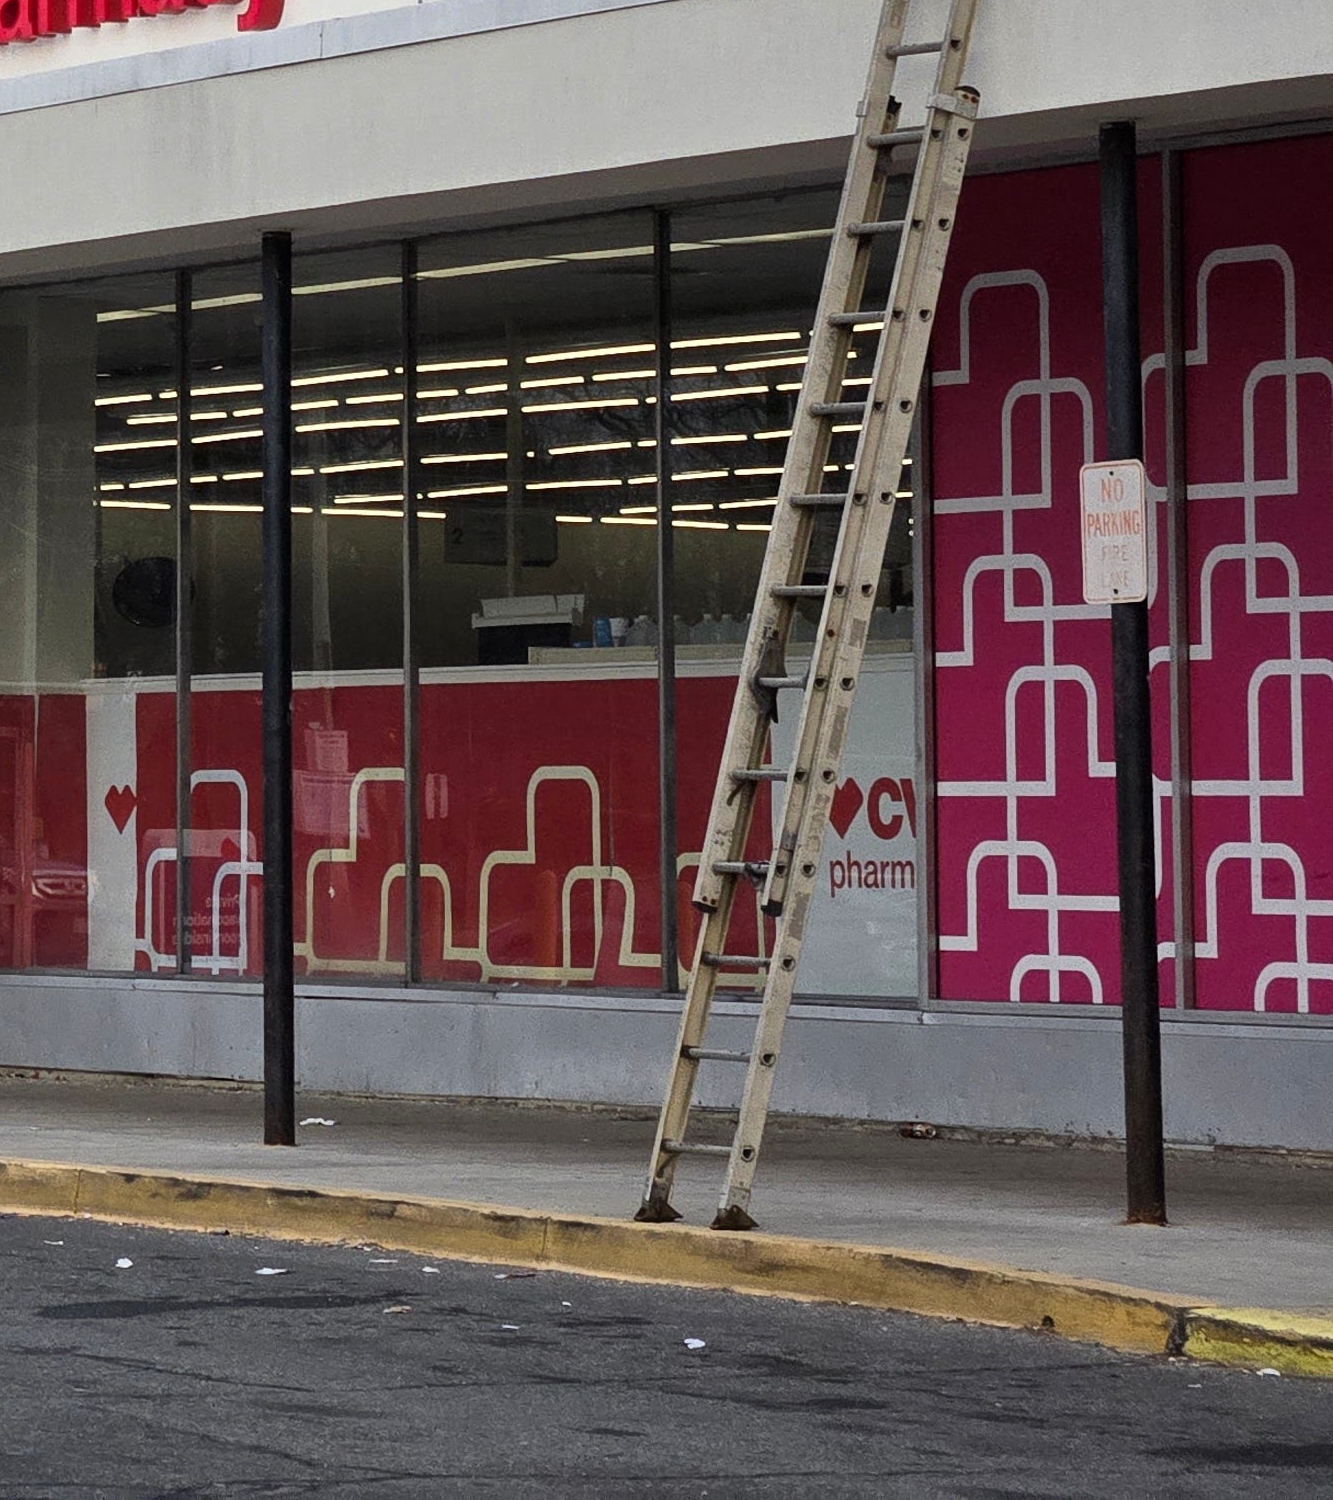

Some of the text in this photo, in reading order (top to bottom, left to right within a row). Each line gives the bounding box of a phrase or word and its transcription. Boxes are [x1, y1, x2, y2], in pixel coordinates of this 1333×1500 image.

[1101, 478, 1125, 503] NO
[1086, 510, 1141, 537] PARKING
[1101, 544, 1129, 561] FIRE
[829, 850, 915, 898] pharm
